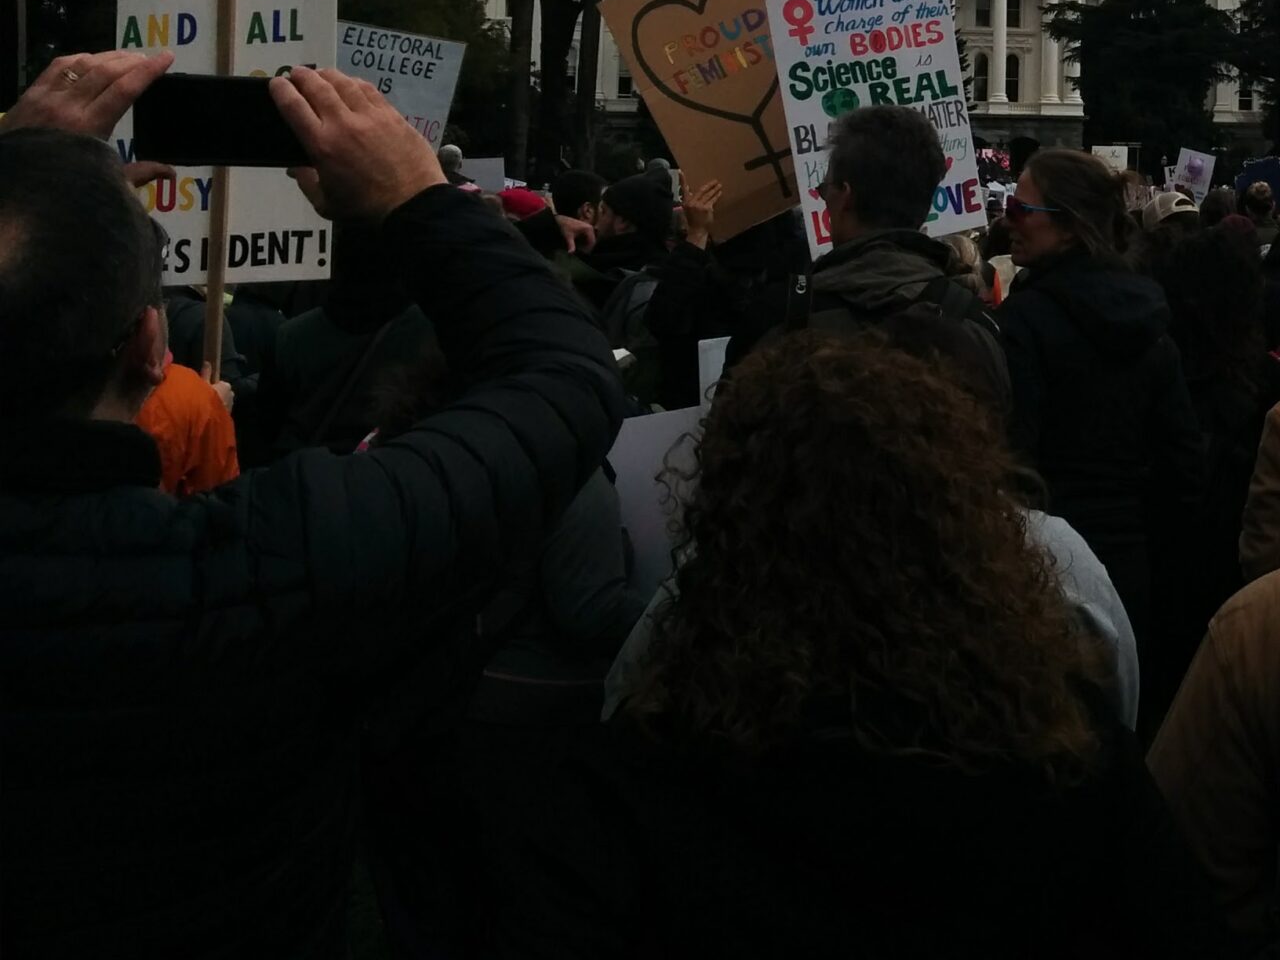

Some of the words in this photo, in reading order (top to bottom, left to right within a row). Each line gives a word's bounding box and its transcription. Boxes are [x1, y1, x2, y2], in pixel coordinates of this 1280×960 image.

[121, 12, 197, 49] AND
[246, 8, 304, 45] ALL
[664, 8, 767, 65] PROUD
[824, 15, 884, 35] charge
[891, 4, 913, 25] of
[915, 0, 949, 20] their
[342, 26, 444, 61] ELECTORAL
[804, 42, 836, 58] own
[850, 20, 945, 56] BODIES
[350, 49, 437, 80] COLLEGE
[673, 34, 774, 95] FEMINIST
[788, 55, 898, 101] Science
[915, 53, 933, 68] is
[377, 77, 393, 94] IS
[868, 69, 959, 107] REAL
